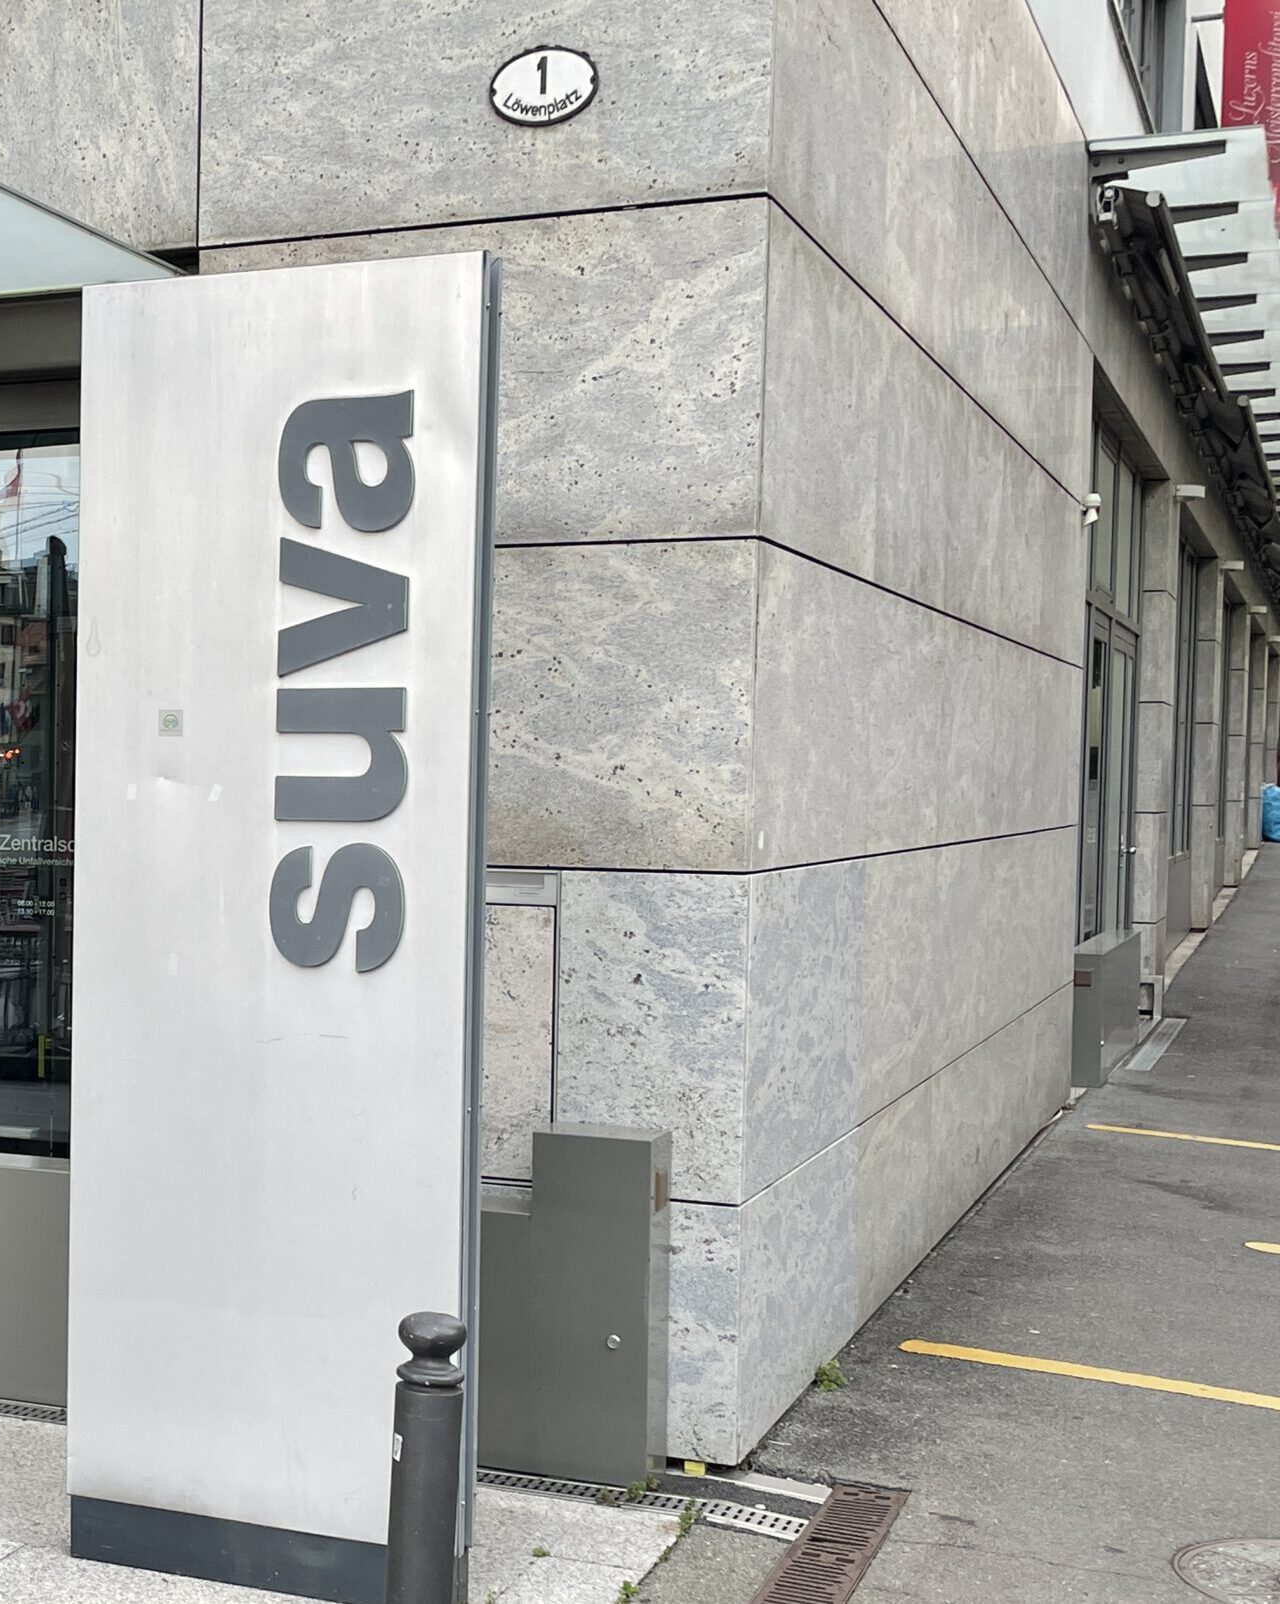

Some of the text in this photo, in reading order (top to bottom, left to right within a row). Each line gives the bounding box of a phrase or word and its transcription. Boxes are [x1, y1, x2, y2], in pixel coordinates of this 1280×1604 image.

[536, 56, 548, 95] 1
[1229, 51, 1265, 124] Luzerns
[503, 89, 582, 121] Löwenplatz
[269, 388, 415, 974] suva
